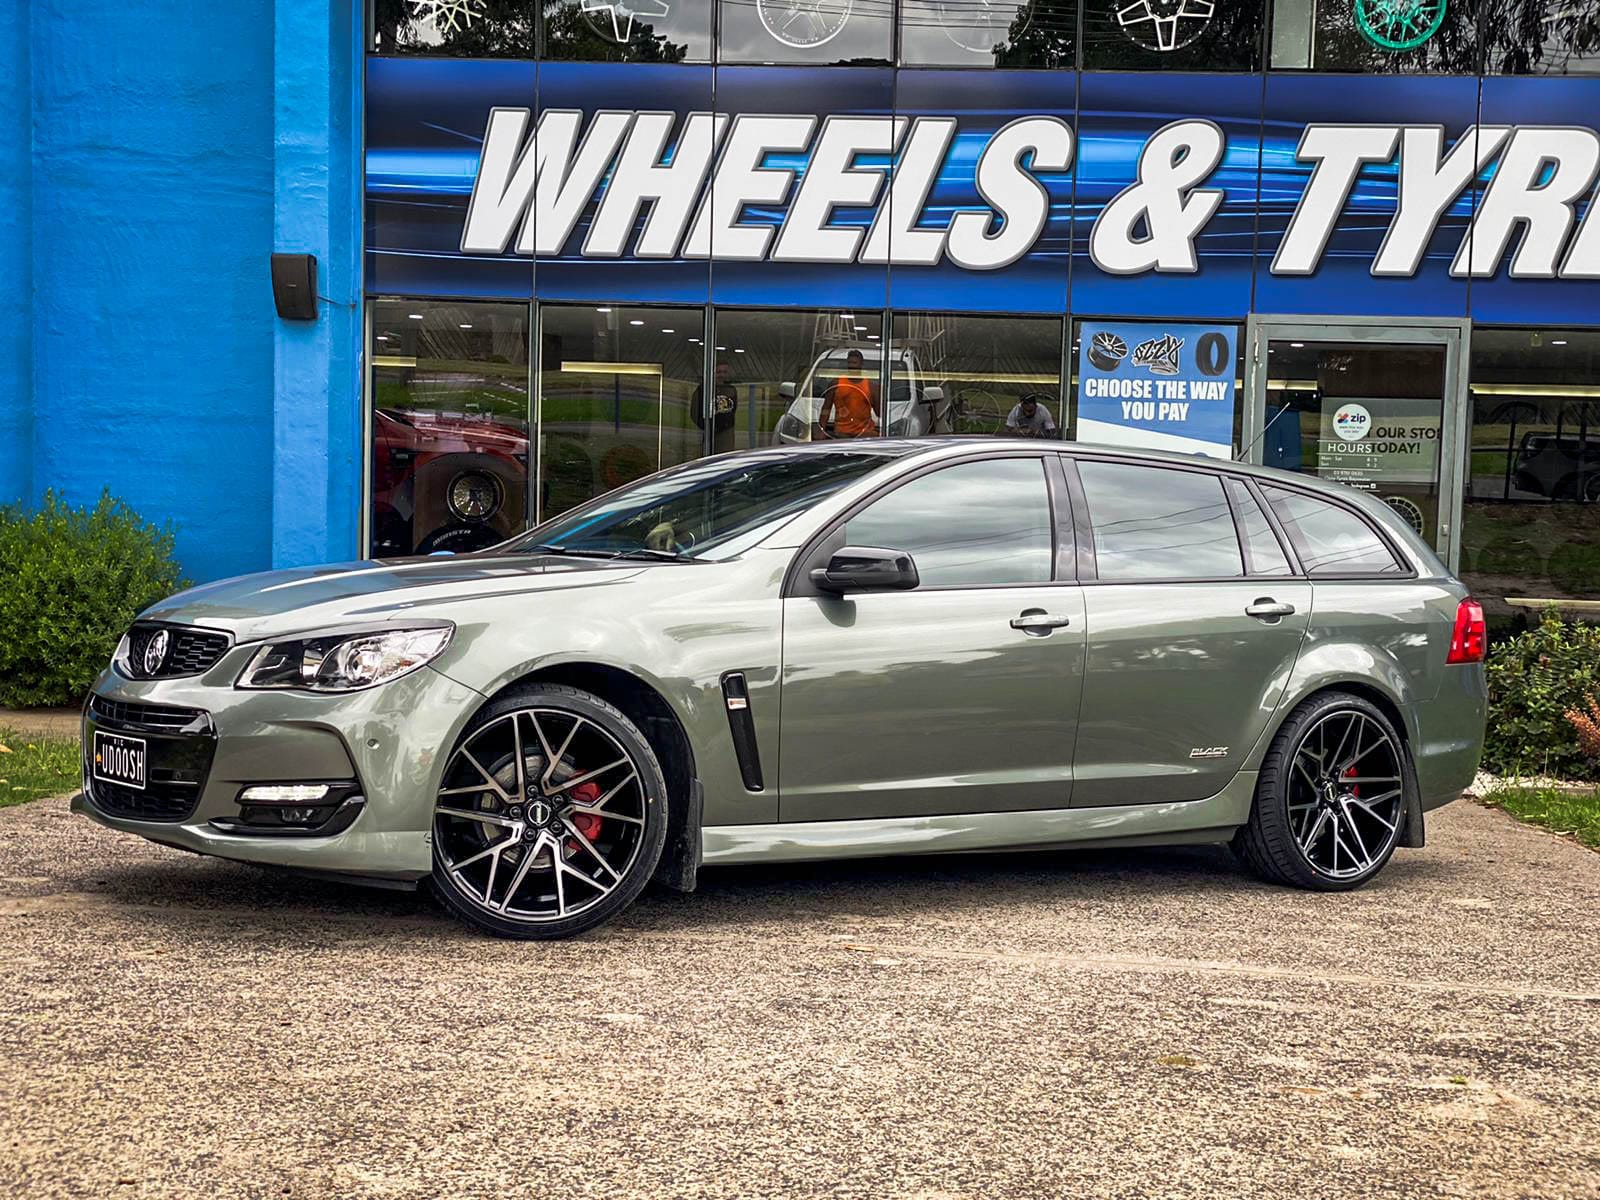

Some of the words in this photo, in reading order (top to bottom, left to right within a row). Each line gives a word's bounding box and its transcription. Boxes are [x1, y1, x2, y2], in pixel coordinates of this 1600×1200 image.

[459, 105, 1075, 271] WHEELS
[1088, 118, 1225, 275] &
[1085, 378, 1153, 398] CHOOSE
[1156, 380, 1187, 399] THE
[1189, 381, 1228, 400] WAY
[1121, 401, 1155, 420] YOU
[1158, 402, 1190, 421] PAY
[1350, 412, 1367, 424] zip
[1376, 426, 1406, 439] OUR
[1327, 442, 1372, 454] HOURS
[1370, 441, 1421, 454] TODAY!
